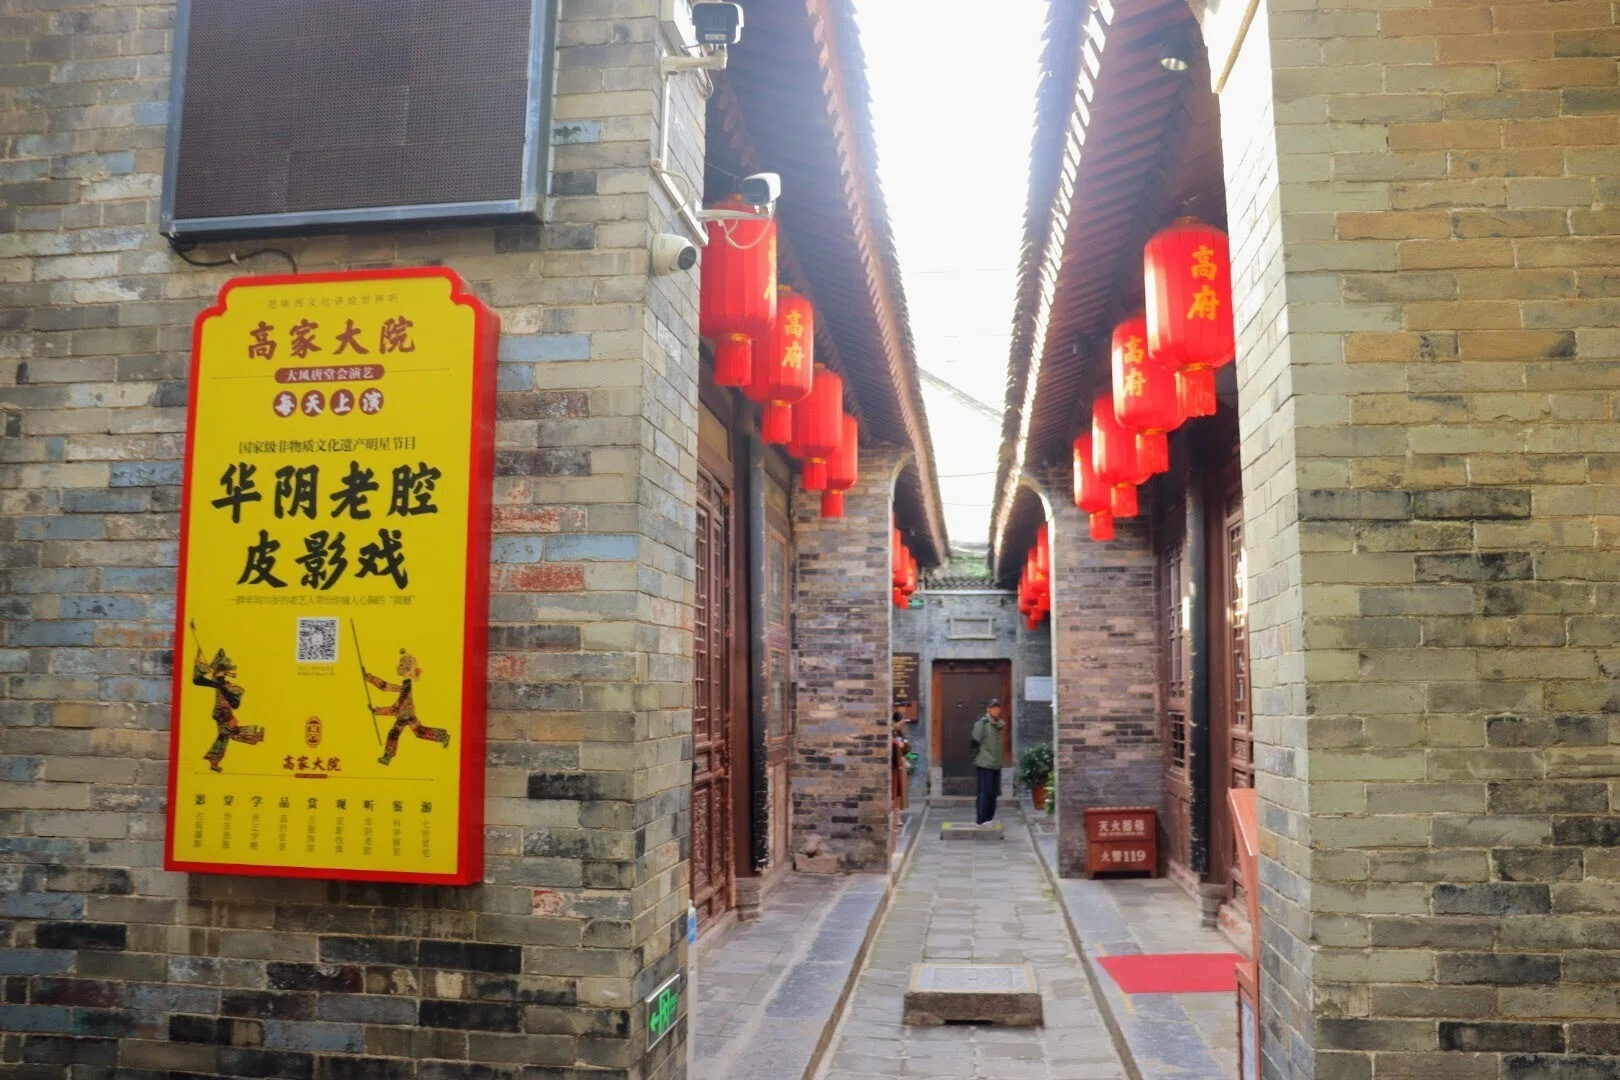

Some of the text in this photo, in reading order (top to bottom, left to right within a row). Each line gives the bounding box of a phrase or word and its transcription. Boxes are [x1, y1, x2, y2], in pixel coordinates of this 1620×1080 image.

[1187, 245, 1220, 320] 高府
[248, 315, 416, 360] 高家大院
[781, 309, 805, 370] 高府
[1124, 336, 1146, 396] 高府
[275, 391, 381, 415] 每天上演
[238, 436, 416, 454] 国家级非物质文化遗产明星节目
[211, 460, 442, 524] 华阴老腔
[236, 528, 408, 590] 皮影戏
[282, 755, 341, 771] 高家大院
[279, 797, 290, 808] 品
